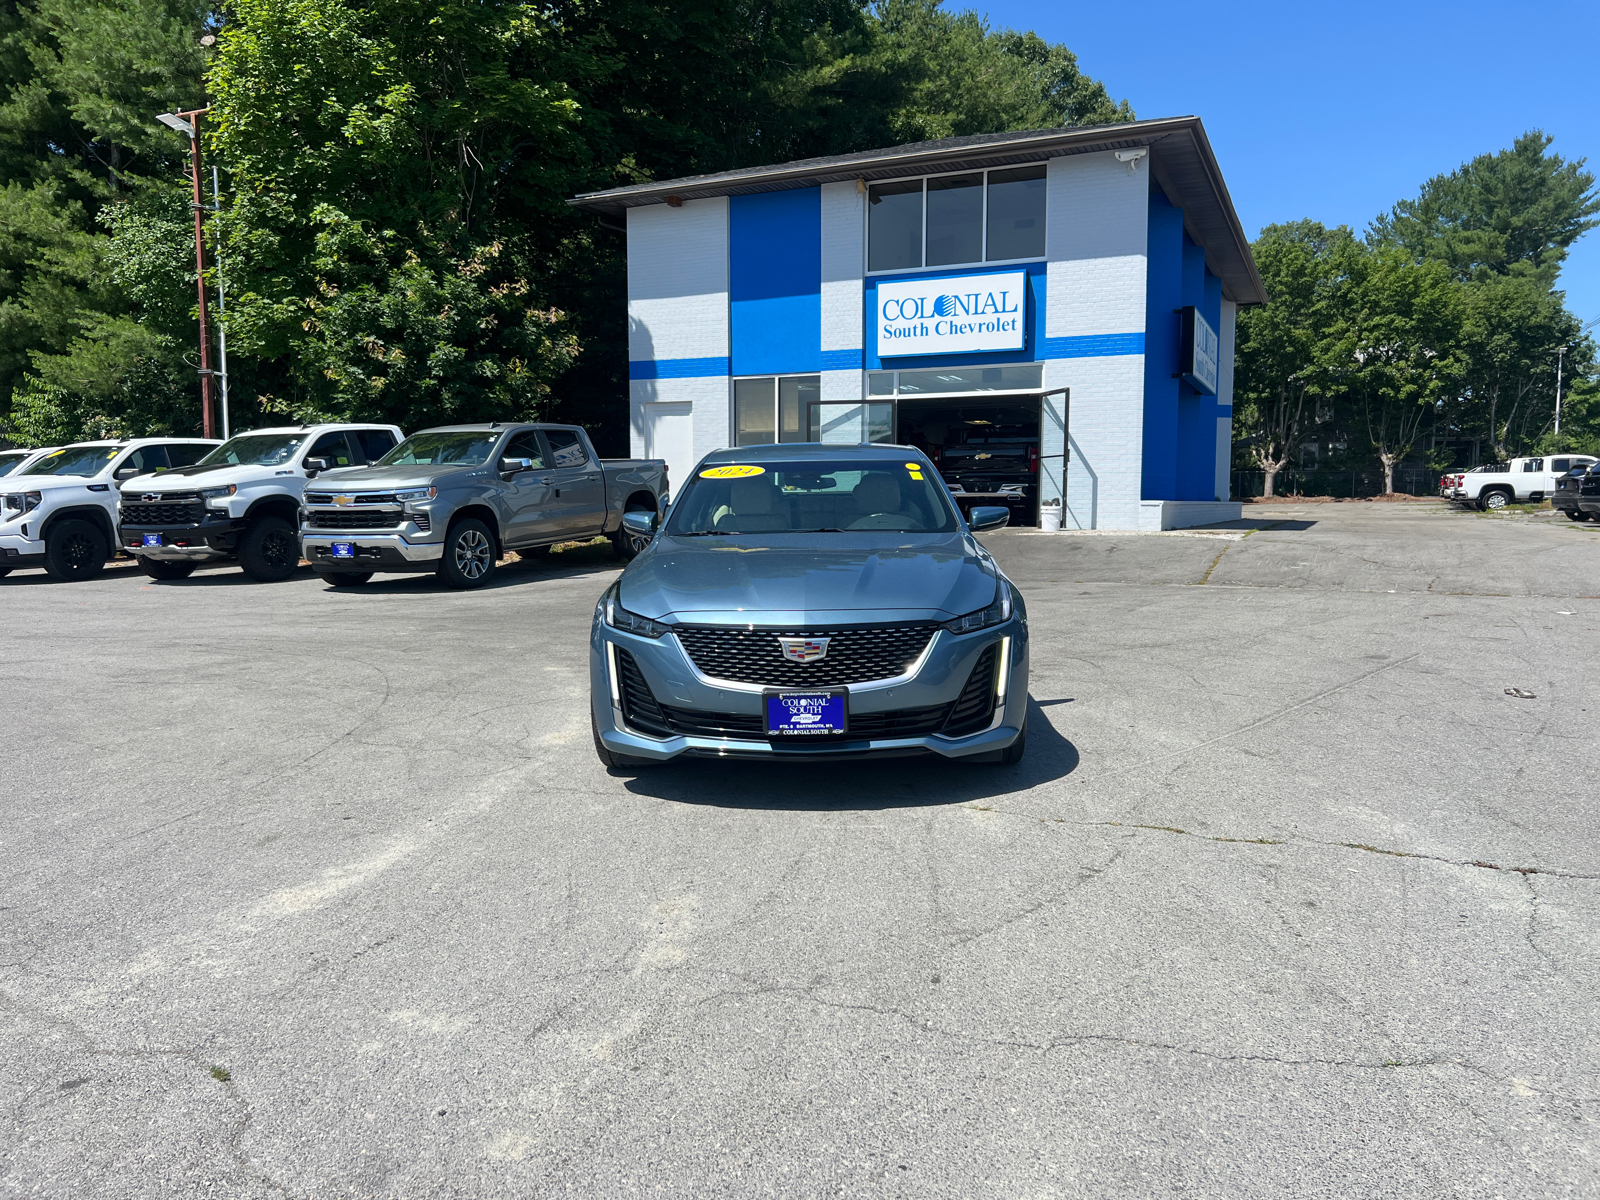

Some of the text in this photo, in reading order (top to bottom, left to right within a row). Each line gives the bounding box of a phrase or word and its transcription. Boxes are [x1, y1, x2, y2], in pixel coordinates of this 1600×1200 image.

[882, 291, 1018, 321] COLONIAL
[883, 317, 1018, 339] South Chevrolet
[709, 467, 755, 476] 2024
[782, 698, 829, 706] COLONIAL
[789, 706, 822, 714] SOUTH
